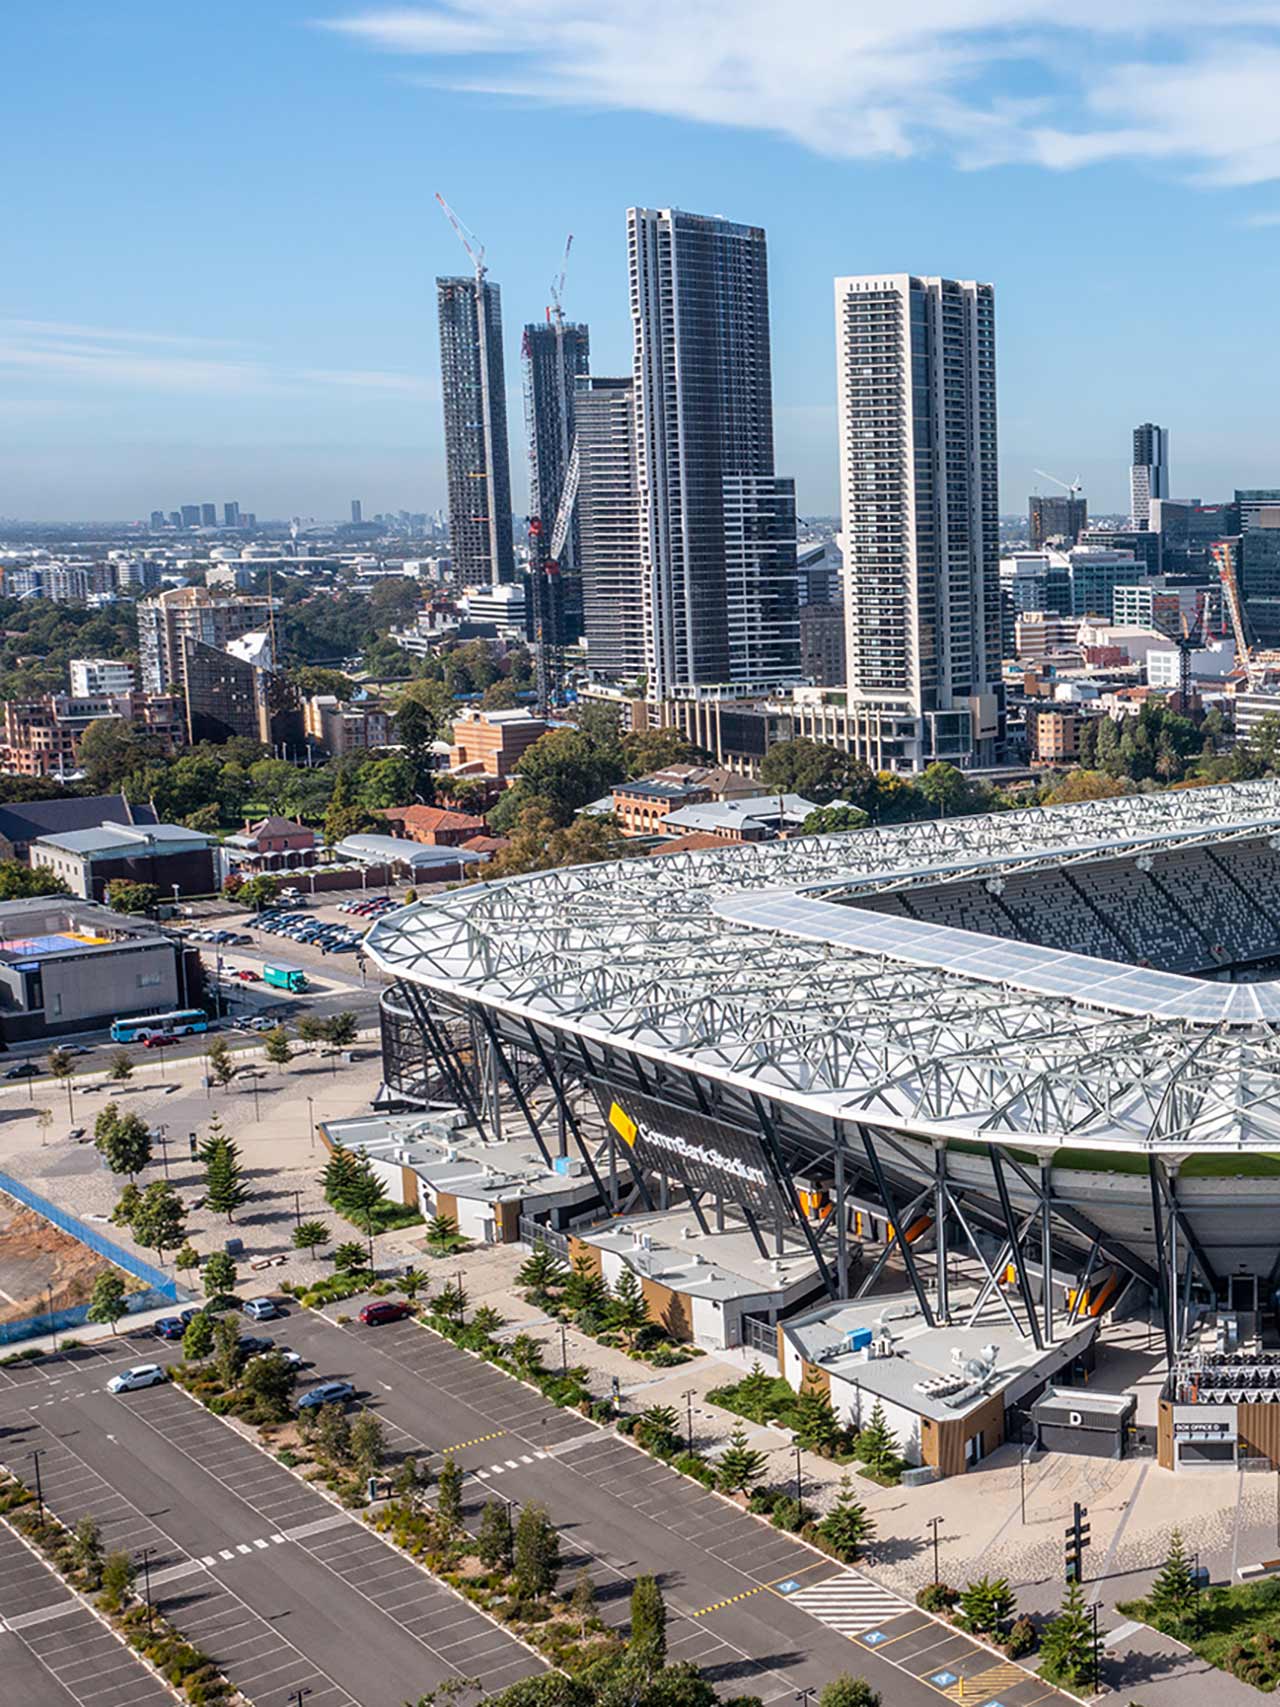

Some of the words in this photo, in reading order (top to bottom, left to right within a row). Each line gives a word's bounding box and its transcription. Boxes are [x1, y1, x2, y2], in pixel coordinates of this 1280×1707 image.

[1069, 1411, 1082, 1425] D
[1176, 1423, 1190, 1431] BOX
[1191, 1423, 1212, 1431] OFFICE
